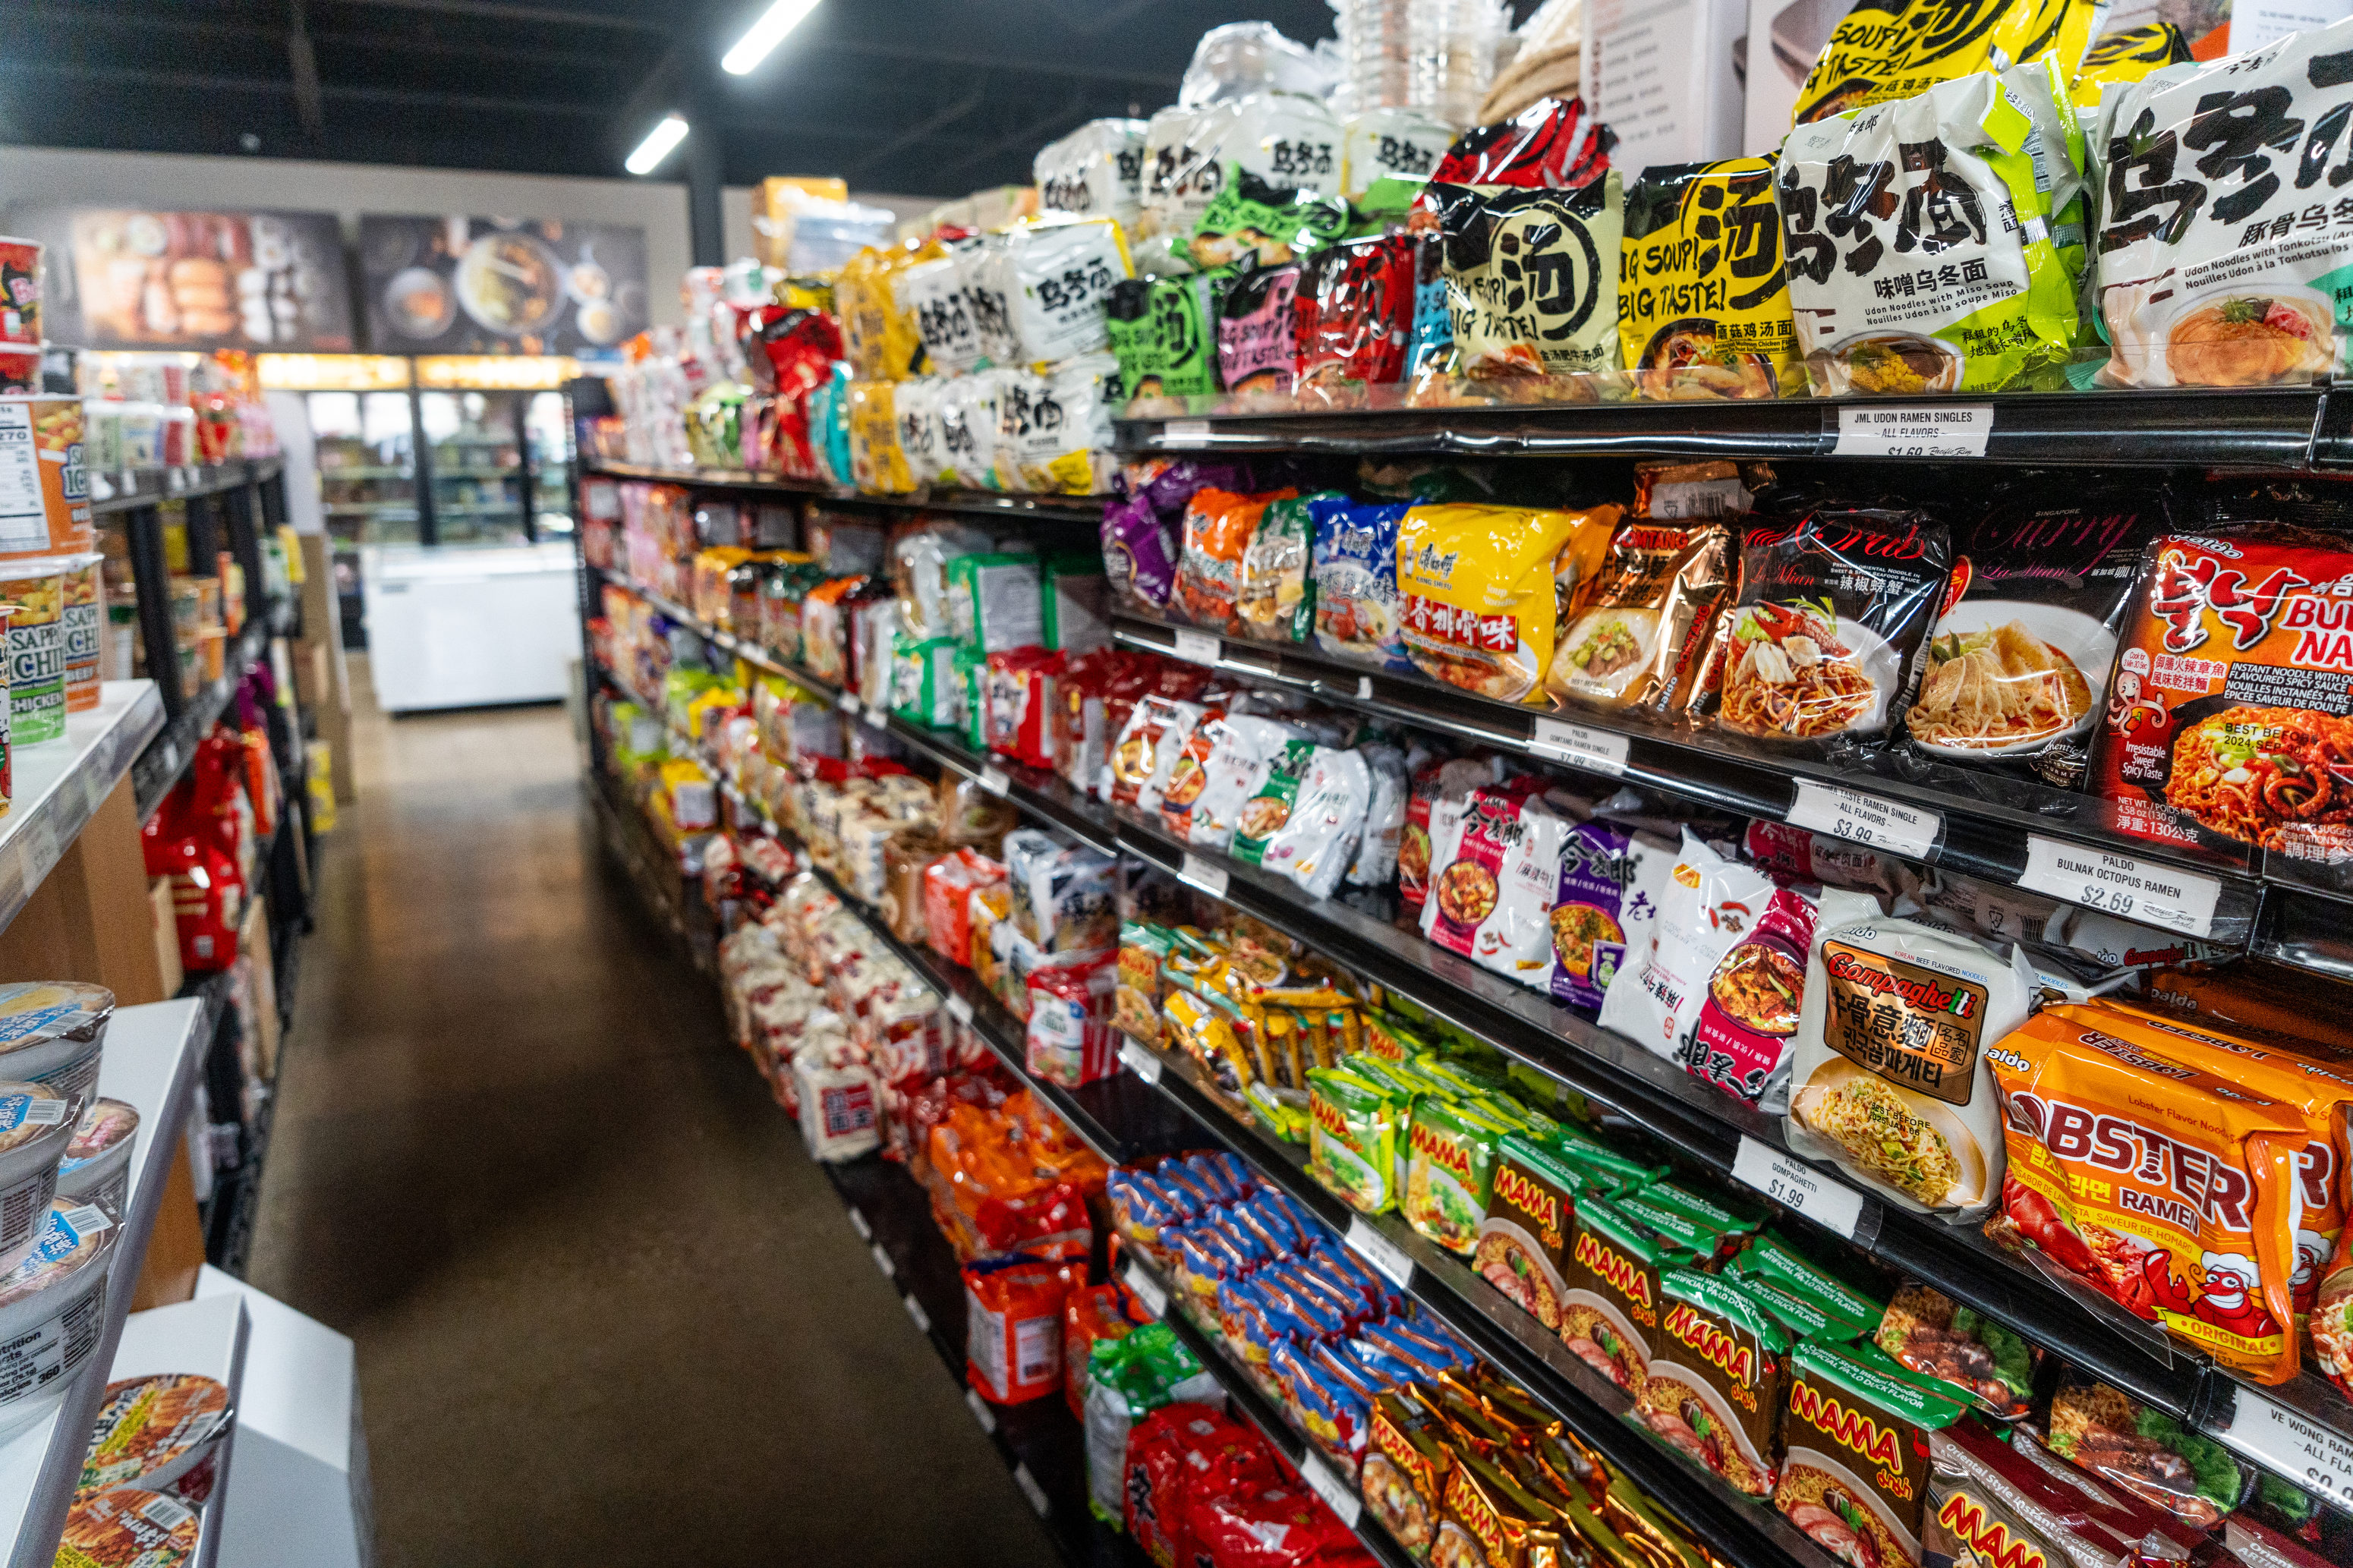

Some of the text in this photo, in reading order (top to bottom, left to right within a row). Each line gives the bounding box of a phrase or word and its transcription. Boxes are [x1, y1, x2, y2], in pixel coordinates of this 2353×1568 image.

[1825, 52, 1911, 85] TASTE!
[1696, 170, 1778, 279] 汤
[1501, 222, 1577, 316] 汤
[1643, 236, 1699, 276] SOUP!
[2184, 234, 2329, 279] Udon Noodles with Tonkotsu
[2186, 247, 2329, 290] Nouilles Udon la Tonkotsu
[1874, 257, 1988, 301] 味噌乌冬面
[1618, 276, 1726, 323] BIG TASTE!
[1865, 279, 2014, 316] Udon Noodles with Miso Soup
[1867, 288, 2018, 326] Nouilles Udon la soupe Miso
[1717, 319, 1793, 341] 蘑菇鸡汤面
[1759, 339, 1781, 348] Chicken
[1855, 412, 1973, 423] JML UDON RAMEN SINGLES
[2035, 508, 2081, 518] SINGAPORE
[2169, 534, 2244, 559] paldo
[1840, 575, 1904, 597] 辣椒螃蟹
[1674, 604, 1711, 675] GOMTANG
[2129, 651, 2140, 660] Cook
[2150, 671, 2210, 692] 風味乾拌麵
[2229, 670, 2348, 693] FLAVOURED SPICY SAUCE
[2232, 663, 2339, 682] INSTANT NOODLE WITH
[1656, 675, 1678, 713] paldo
[2224, 688, 2348, 714] ÉPICÉE SAVEUR DE POULPE
[2225, 680, 2351, 705] NOUILLES AVEC
[1549, 734, 1611, 757] GOMTANG RAMEN SINGLE
[1572, 729, 1588, 739] PALDO
[2225, 723, 2258, 735] BEST
[2126, 741, 2166, 758] Irresistable
[2132, 754, 2155, 768] Sweet
[2122, 762, 2163, 781] Spicy Taste
[1482, 797, 1509, 811] JML
[1839, 789, 1918, 825] TASTE RAMEN SINGLE
[2118, 796, 2179, 815] NET WT. POIDS
[2118, 806, 2135, 817] 4.58
[2148, 810, 2167, 823] (130
[2169, 815, 2178, 825] g)
[2057, 858, 2181, 899] BULNAK OCTOPUS RAMEN
[2103, 855, 2134, 872] PALDO
[2081, 883, 2134, 915] $2.69
[1894, 950, 1988, 983] KOREAN BEEF FLAVORED NOODLES
[2123, 941, 2198, 969] Gompaghetti
[1827, 951, 1978, 1019] Gompaghetti
[2040, 974, 2069, 990] NOODLES
[2150, 987, 2198, 1010] paldo
[1830, 985, 1936, 1053] 牛骨意麵
[1369, 1025, 1404, 1060] MAMA
[1842, 1025, 1945, 1090] 진국곰파게티
[2078, 1031, 2201, 1081] LOBSTER
[2112, 1037, 2144, 1053] RAMEN
[1309, 1088, 1353, 1138] MAMA
[1871, 1102, 1932, 1130] BEST BEFORE
[2128, 1094, 2199, 1127] Lobster Flavor
[1410, 1120, 1474, 1179] MAMA
[1785, 1157, 1806, 1176] PALDO
[1769, 1178, 1804, 1209] $1.99
[1772, 1162, 1818, 1194] GOMPAGHETTI
[1493, 1163, 1557, 1232] MAMA
[2016, 1170, 2194, 1255] SABOR DE SAVEUR DE HOMARD
[2118, 1185, 2200, 1239] RAMEN
[1574, 1230, 1653, 1310] MAMA
[1758, 1249, 1866, 1318] ARTIFICIAL PA-LO DUCK FLAVOR
[1769, 1247, 1866, 1312] Oriental Style Noodles
[1665, 1271, 1751, 1313] ARTIFICIAL PA-LO DUCK
[1772, 1295, 1826, 1330] DUCK FLAVOR
[1664, 1301, 1753, 1390] MAMA
[2191, 1318, 2270, 1355] ORIGINAL
[38, 1365, 60, 1384] 360
[1797, 1342, 1926, 1410] ARTIFICIAL PA-LO DUCK FLAVOR
[1808, 1343, 1925, 1402] Oriental Style Instant Noodles
[1790, 1379, 1903, 1475] MAMA
[2270, 1408, 2323, 1444] VE WONG
[1372, 1413, 1425, 1476] MAMA
[1945, 1442, 2014, 1500] Oriental Style
[1450, 1479, 1506, 1557] MAMA
